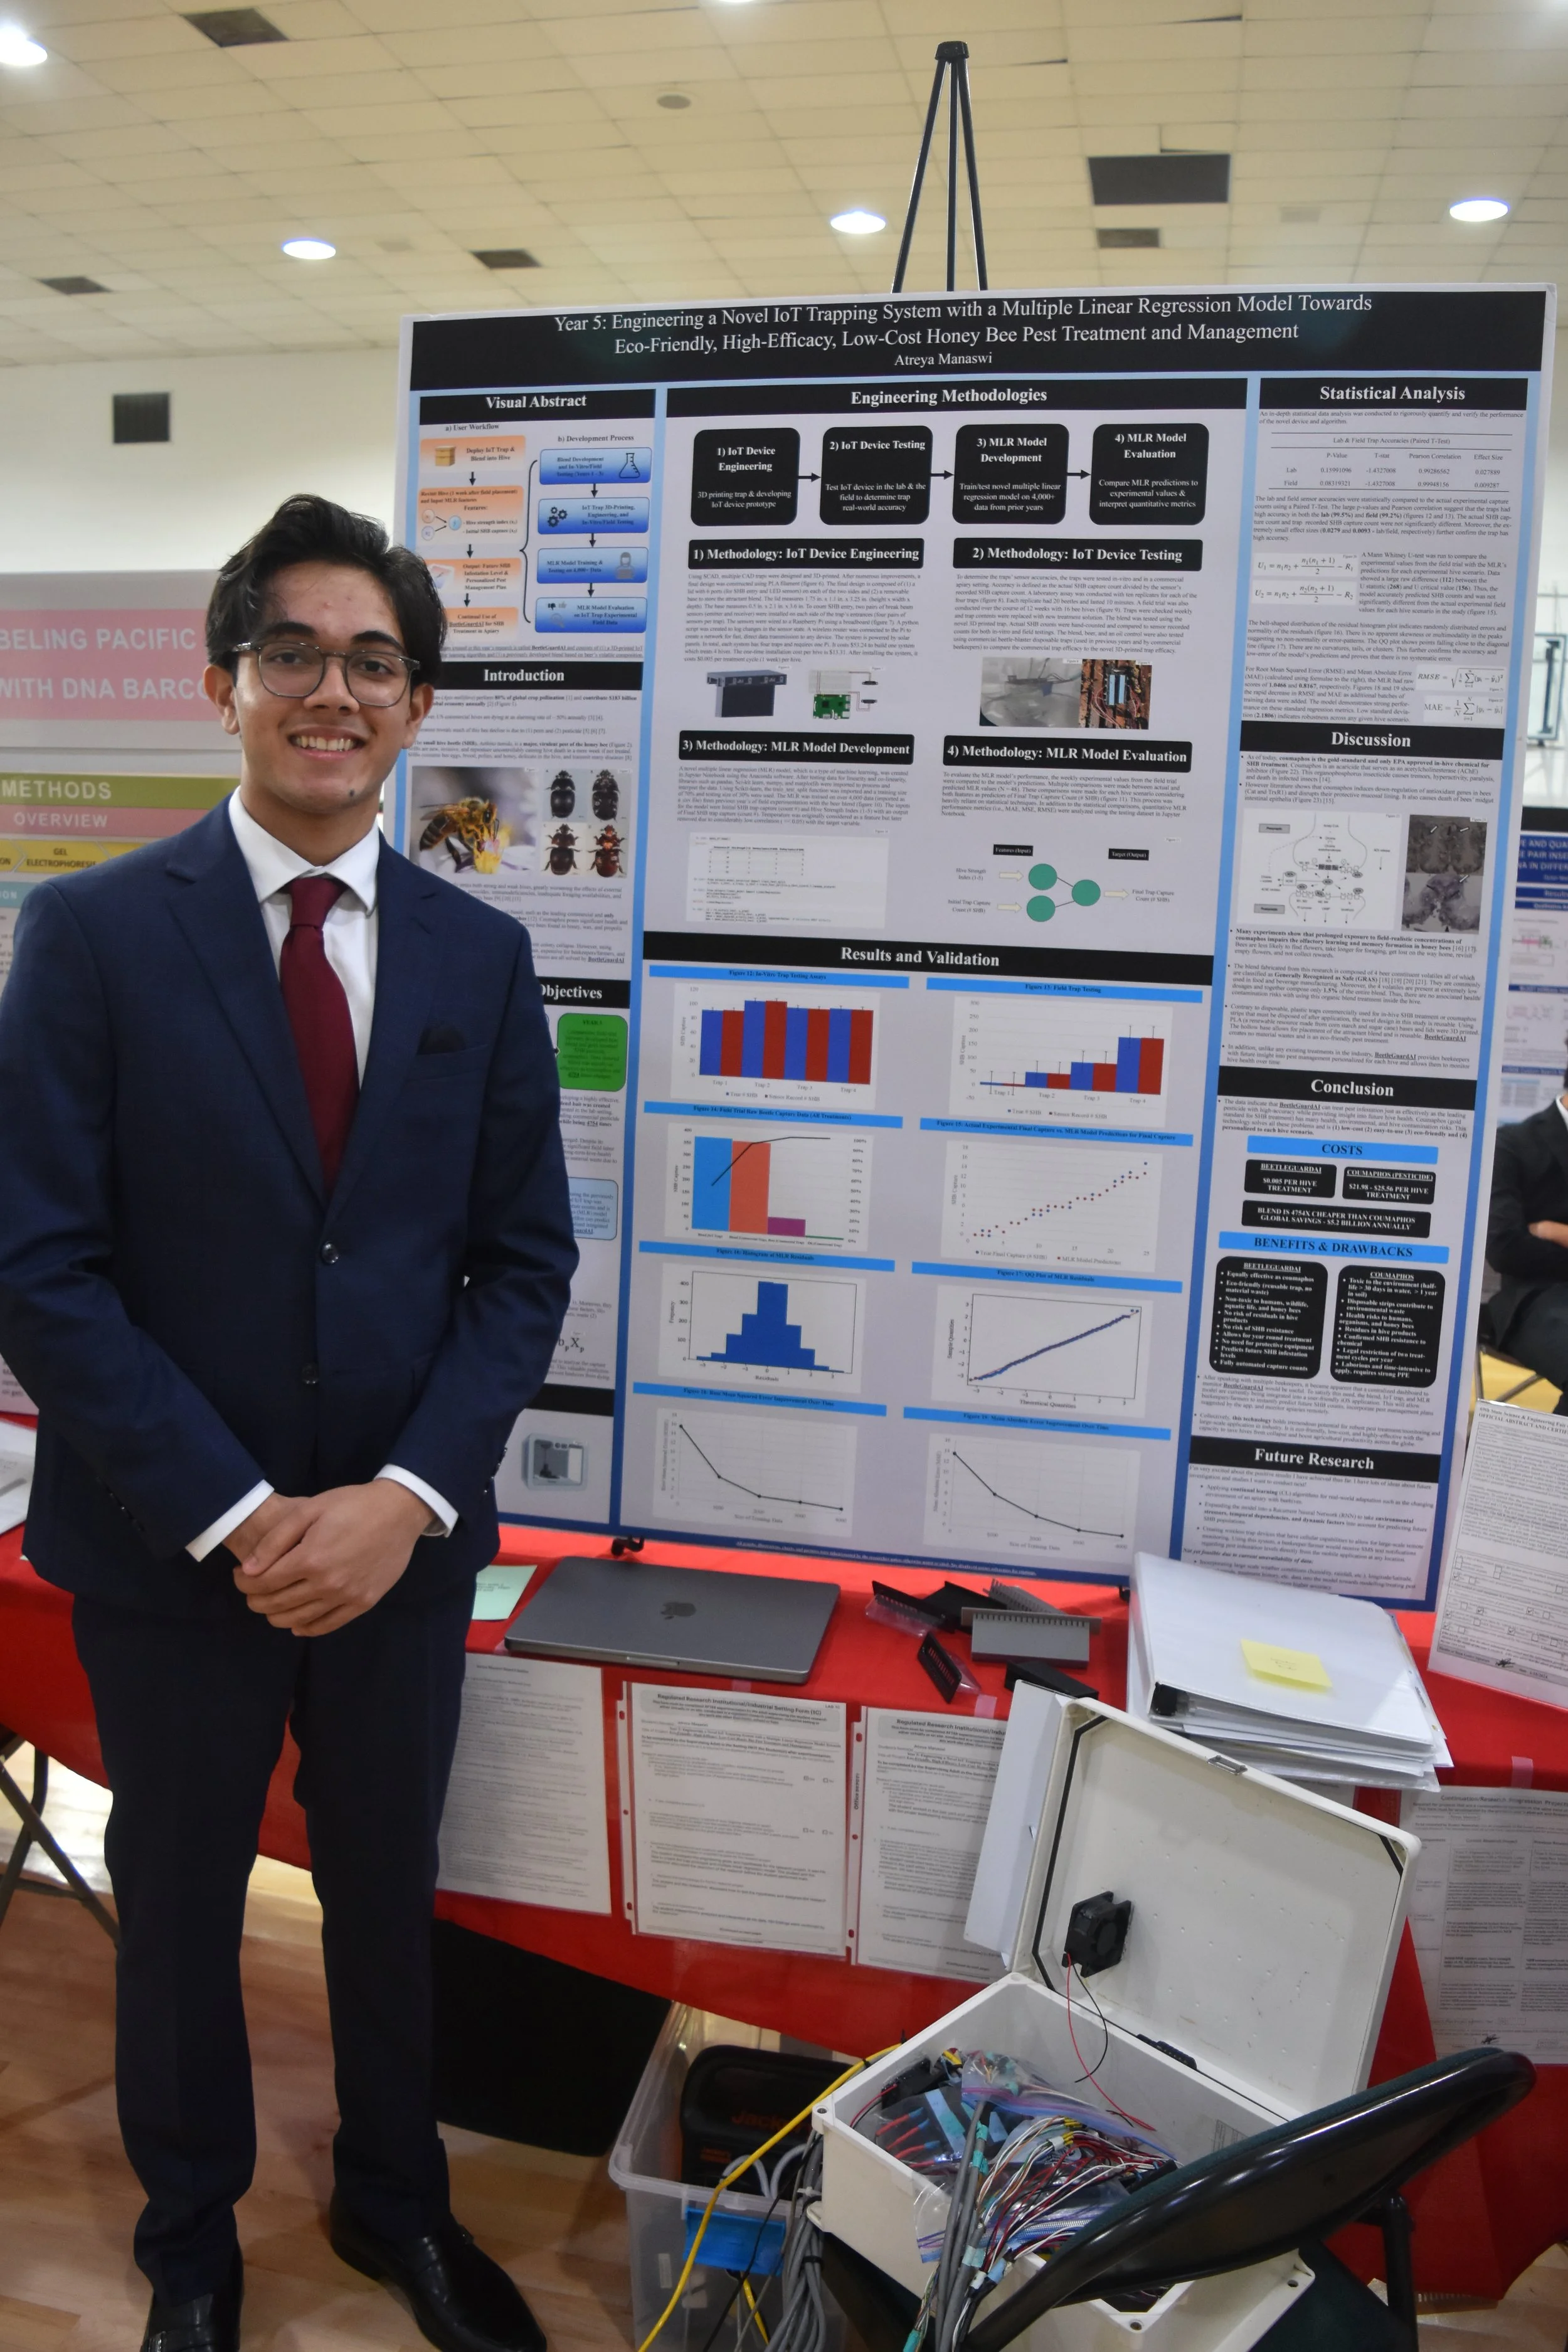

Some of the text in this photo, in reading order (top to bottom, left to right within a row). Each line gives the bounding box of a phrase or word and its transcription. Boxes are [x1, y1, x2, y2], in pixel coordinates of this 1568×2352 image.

[554, 294, 1372, 332] Year 5: Engineering a Novel IoT Trapping System with a Multiple Linear Regression Model Towards
[615, 324, 1299, 354] Eco-Friendly, High-Efficacy, Low-Cost Honey Bee Pest Treatment and Management
[894, 351, 992, 368] Atreya Manaswi
[851, 388, 1047, 408] Engineering Methodologies
[1320, 386, 1465, 403] Statistical Analysis
[486, 395, 587, 409] Visual Abstract
[977, 437, 1047, 448] 3) MLR Model
[1115, 433, 1187, 443] 4) MLR Model
[830, 440, 925, 451] 2) IoT Device Testing
[718, 447, 776, 457] 1) IoT Device
[1124, 449, 1176, 458] Evaluation
[981, 453, 1042, 464] Development
[719, 462, 773, 473] Engineering
[1012, 482, 1041, 491] multiple
[1098, 479, 1130, 488] Compare
[1152, 479, 1190, 488] predictions
[756, 490, 792, 499] developing
[963, 493, 997, 502] regression
[999, 493, 1020, 501] model
[1110, 490, 1154, 499] experimental
[1007, 504, 1025, 512] prior
[1099, 501, 1127, 509] interpret
[1129, 500, 1169, 509] quantitative
[694, 548, 920, 562] 1) Methodology: IoT Device Engineering
[973, 548, 1182, 563] 2) Methodology: IoT Device Testing
[97, 628, 196, 650] PACIFIC
[484, 669, 564, 681] Introduction
[63, 678, 115, 699] DNA
[1332, 732, 1411, 747] Discussion
[682, 739, 911, 757] 3) Methodology: MLR Model Development
[948, 744, 1187, 762] 4) Methodology: MLR Model Evaluation
[2, 780, 112, 800] METHODS
[14, 812, 108, 827] OVERVIEW
[53, 848, 68, 856] GEL
[842, 947, 999, 967] Results and Validation
[1311, 1079, 1394, 1096] Conclusion
[1322, 1144, 1362, 1155] COSTS
[1261, 1163, 1322, 1174] BEETLEGUARDAI
[1347, 1169, 1434, 1182] COUMAPHOS (PESTICIDE)
[1268, 1185, 1311, 1193] TREATMENT
[1254, 1237, 1413, 1256] BENEFITS & DRAWBACKS
[1243, 1263, 1301, 1273] BEETLEGUARDAI
[1370, 1271, 1414, 1281] COUMAPHOS
[1255, 1448, 1374, 1470] Future Research
